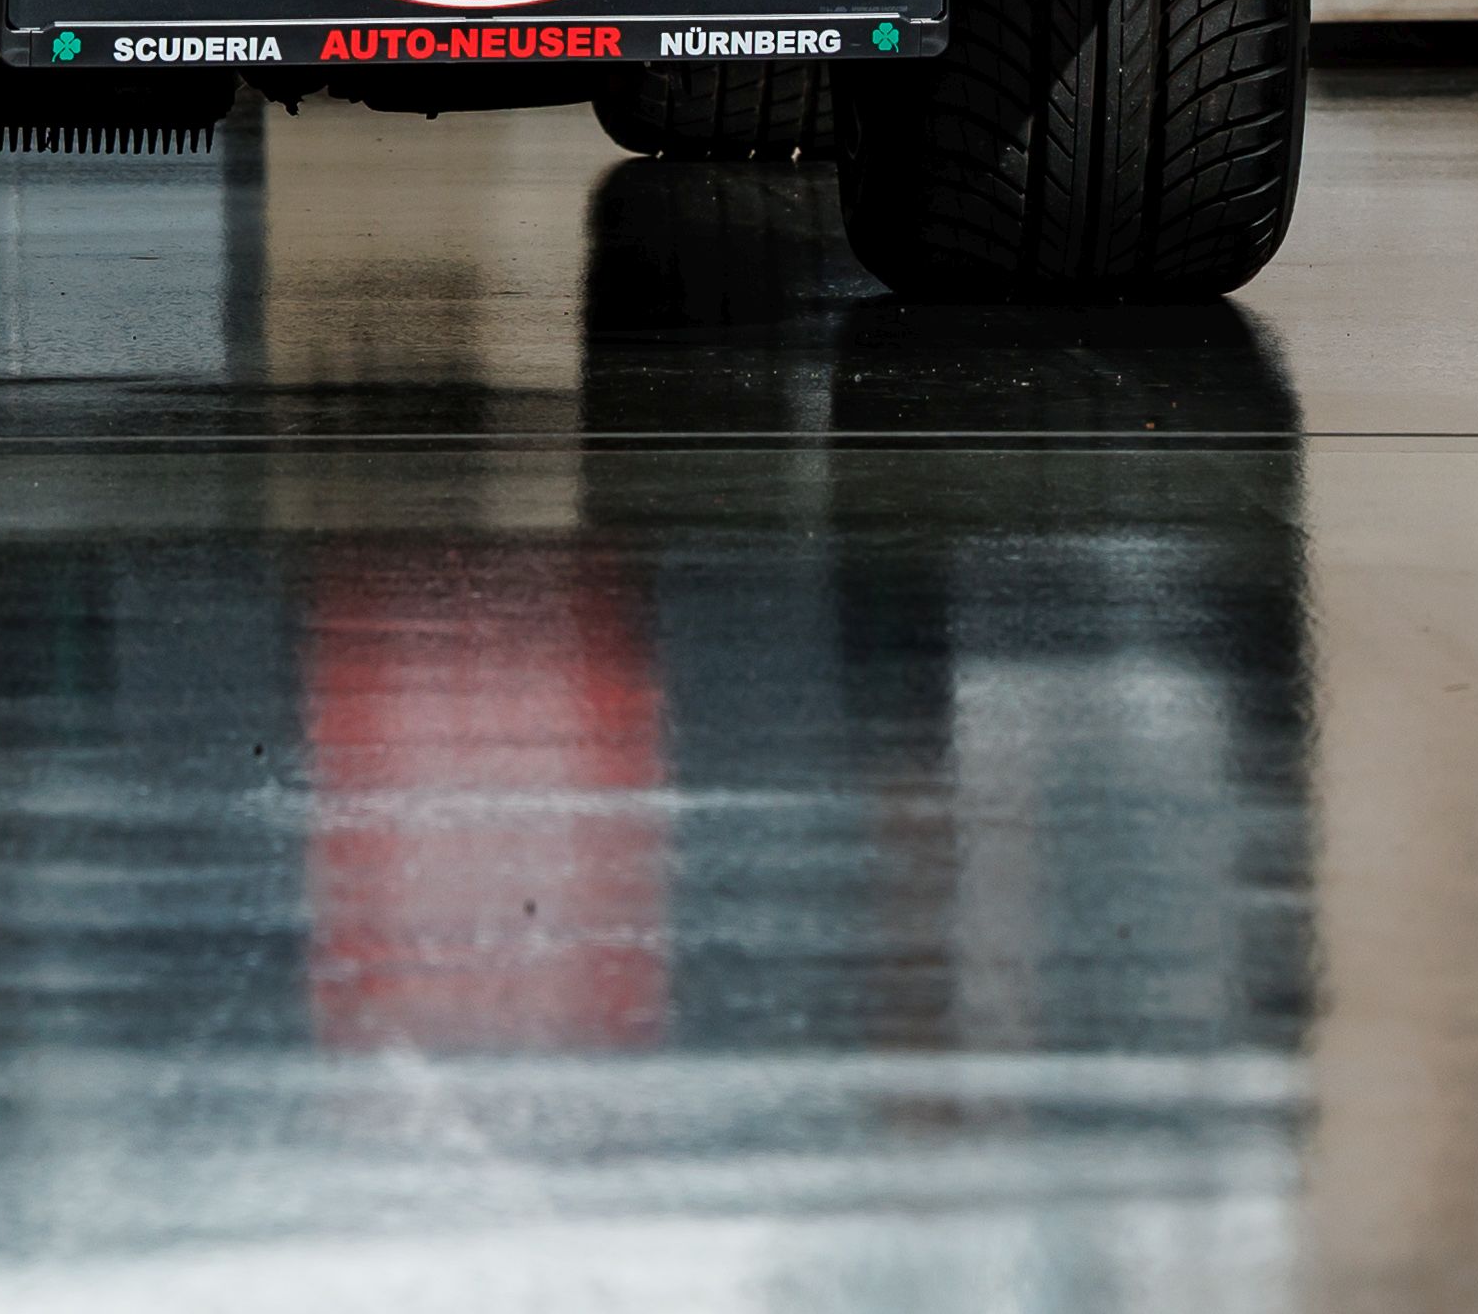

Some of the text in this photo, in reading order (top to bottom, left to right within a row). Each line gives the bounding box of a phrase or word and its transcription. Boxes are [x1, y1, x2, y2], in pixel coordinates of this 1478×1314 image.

[113, 26, 841, 62] SCUDERIA AUTO-NEUSER NÜRNBERG
